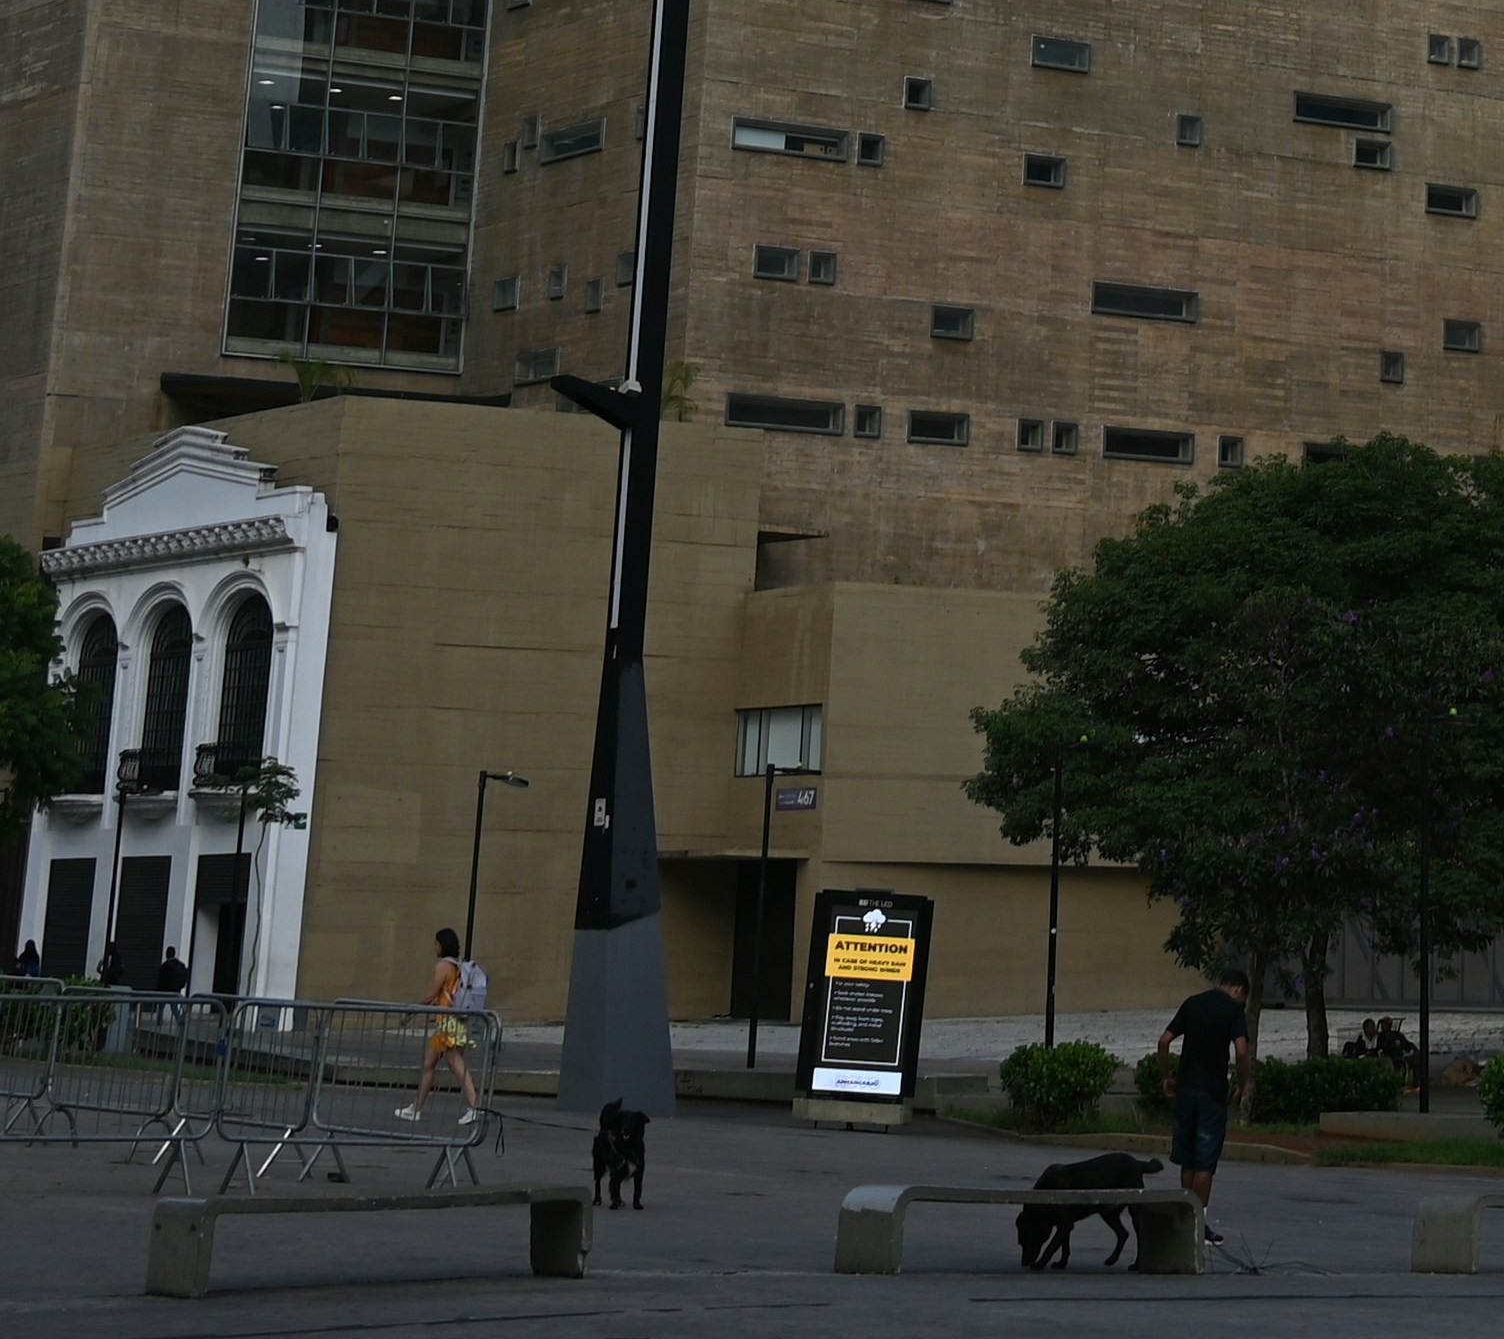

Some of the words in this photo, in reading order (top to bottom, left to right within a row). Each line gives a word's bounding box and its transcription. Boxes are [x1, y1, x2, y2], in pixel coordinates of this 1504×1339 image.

[797, 789, 815, 806] 467
[880, 899, 893, 908] LED
[835, 940, 908, 955] ATTENTION
